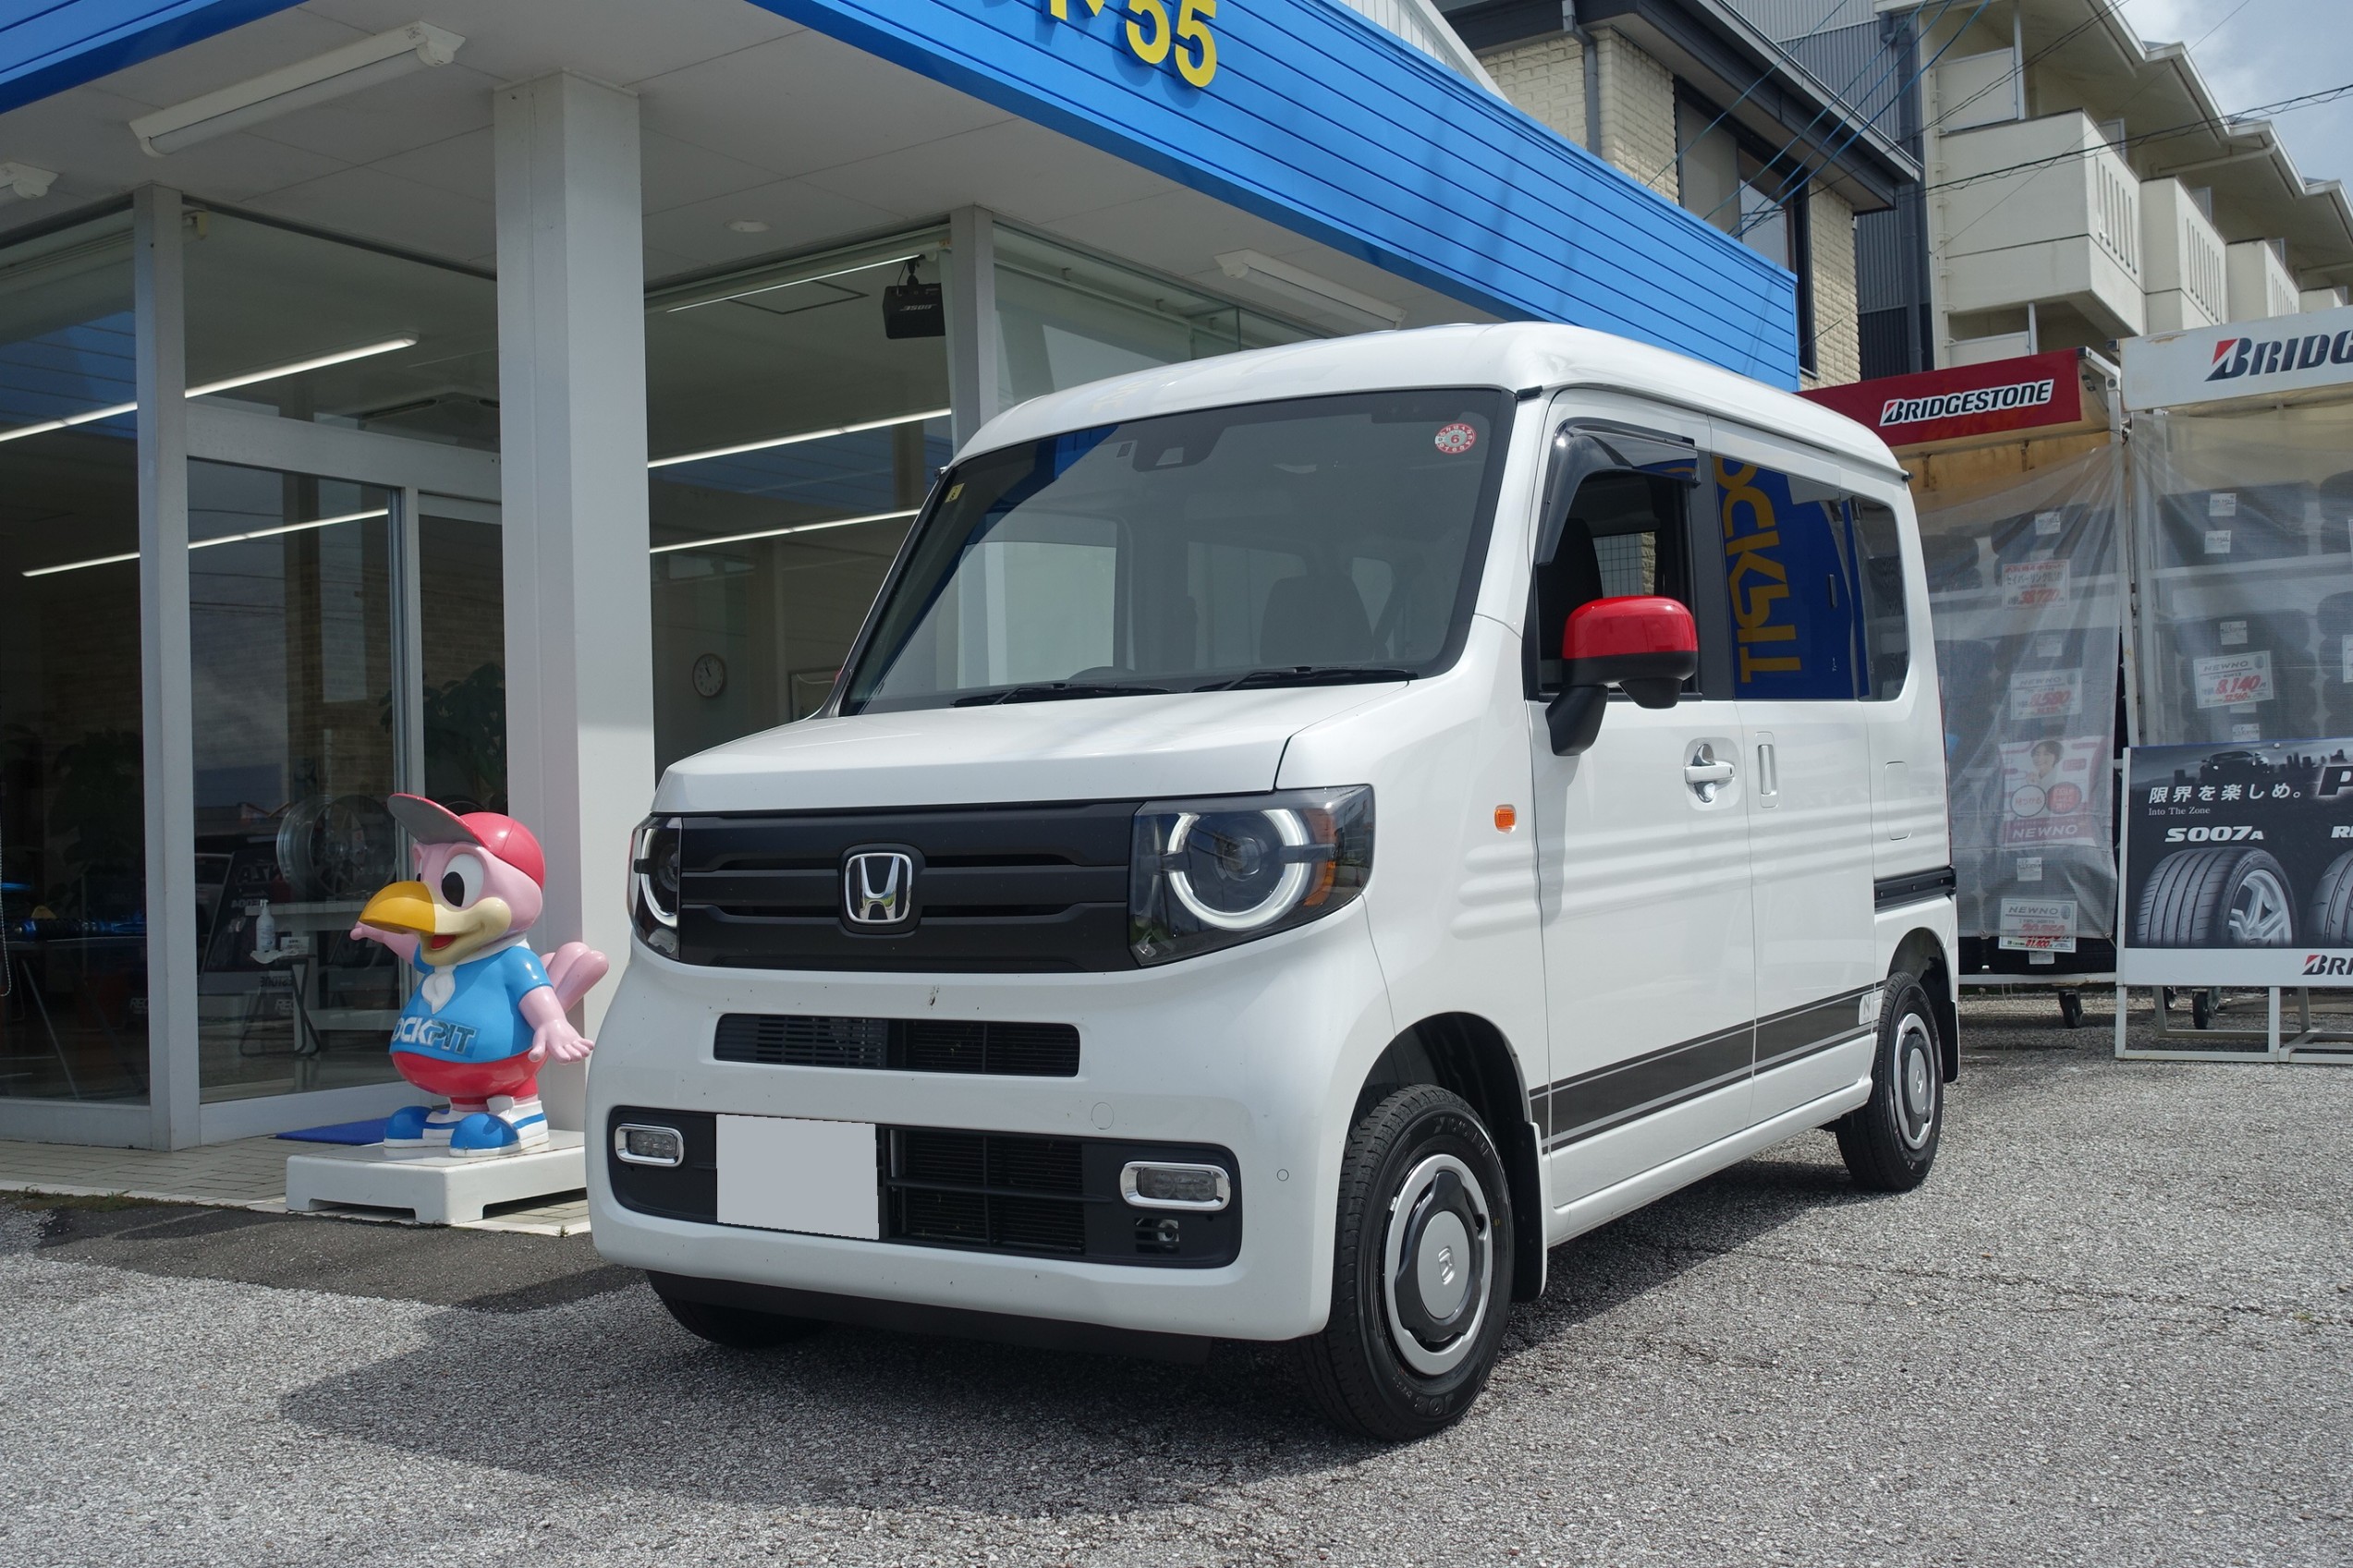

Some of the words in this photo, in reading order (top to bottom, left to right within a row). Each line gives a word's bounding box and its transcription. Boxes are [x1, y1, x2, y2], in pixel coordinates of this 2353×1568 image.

[1881, 380, 2054, 426] BRIDGESTONE
[2203, 660, 2249, 673] NEWNO
[2148, 783, 2301, 804] 限界を楽しめ。
[2148, 808, 2165, 816] Into
[2169, 807, 2187, 815] The
[2188, 806, 2211, 815] Zone
[2012, 824, 2079, 839] NEWNO
[2164, 825, 2264, 842] S007A
[2008, 906, 2059, 915] NEWNO
